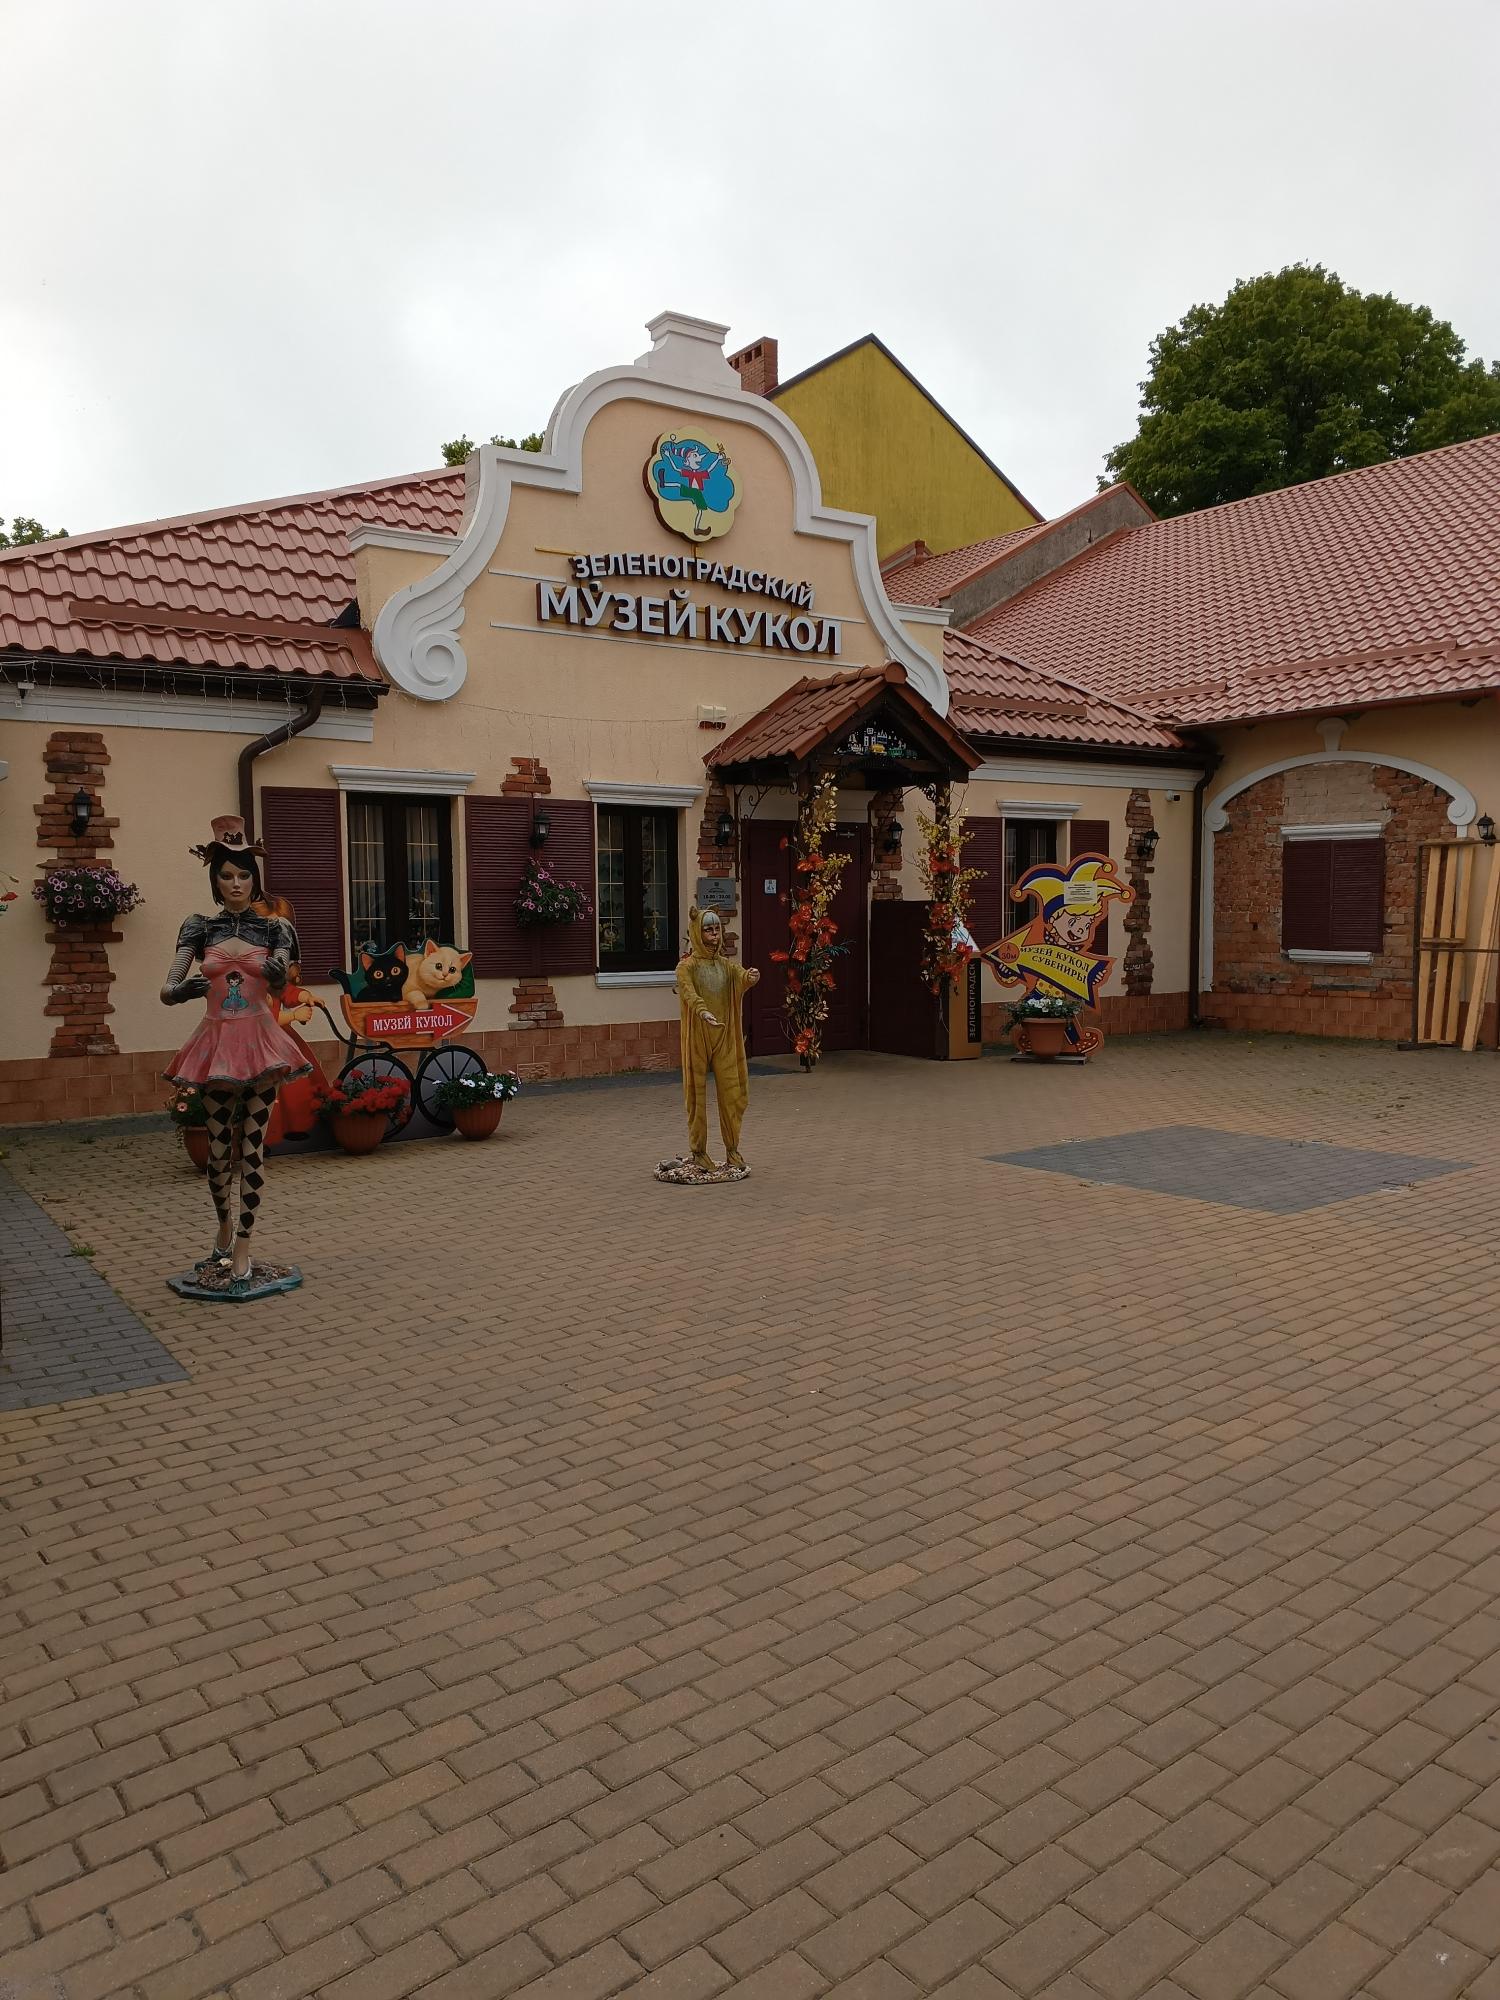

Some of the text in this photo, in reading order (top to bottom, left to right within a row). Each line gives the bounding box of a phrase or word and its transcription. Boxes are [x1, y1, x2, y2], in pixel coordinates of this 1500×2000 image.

[571, 553, 816, 611] ЗЕЛЕНОГРАДСКИЙ
[537, 581, 842, 656] МУЗЕЙ КУКОЛ
[1020, 947, 1090, 973] МУЗЕЙ КУКОЛ
[1031, 955, 1087, 984] СУВЕНИРЫ
[373, 1014, 453, 1032] МУЗЕЙ КУКОЛ
